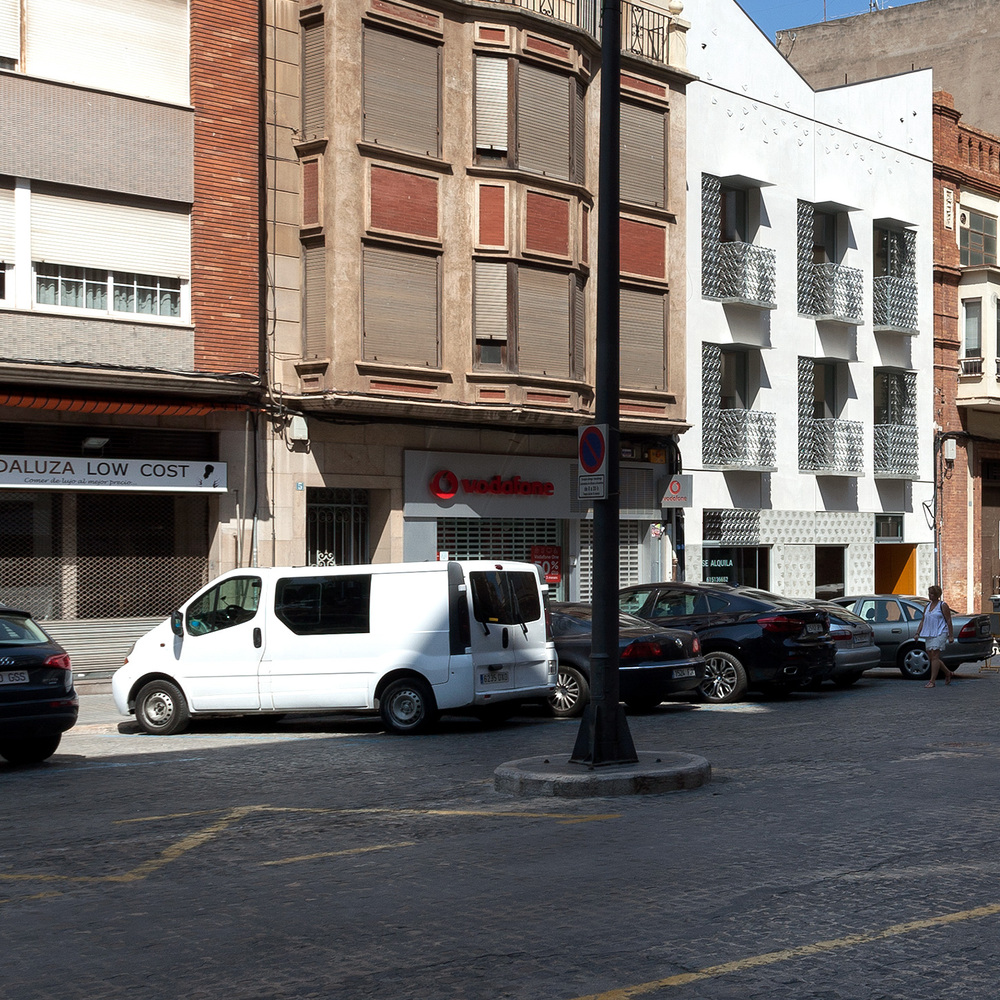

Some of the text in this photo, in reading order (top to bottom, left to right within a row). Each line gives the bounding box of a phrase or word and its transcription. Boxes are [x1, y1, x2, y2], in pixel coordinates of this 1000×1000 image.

[87, 461, 128, 476] LOW
[140, 463, 190, 478] COST
[61, 478, 76, 486] lujo
[297, 482, 304, 491] 5
[461, 475, 555, 496] vodafone
[710, 559, 734, 568] ALQUILA
[8, 672, 27, 682] GSS
